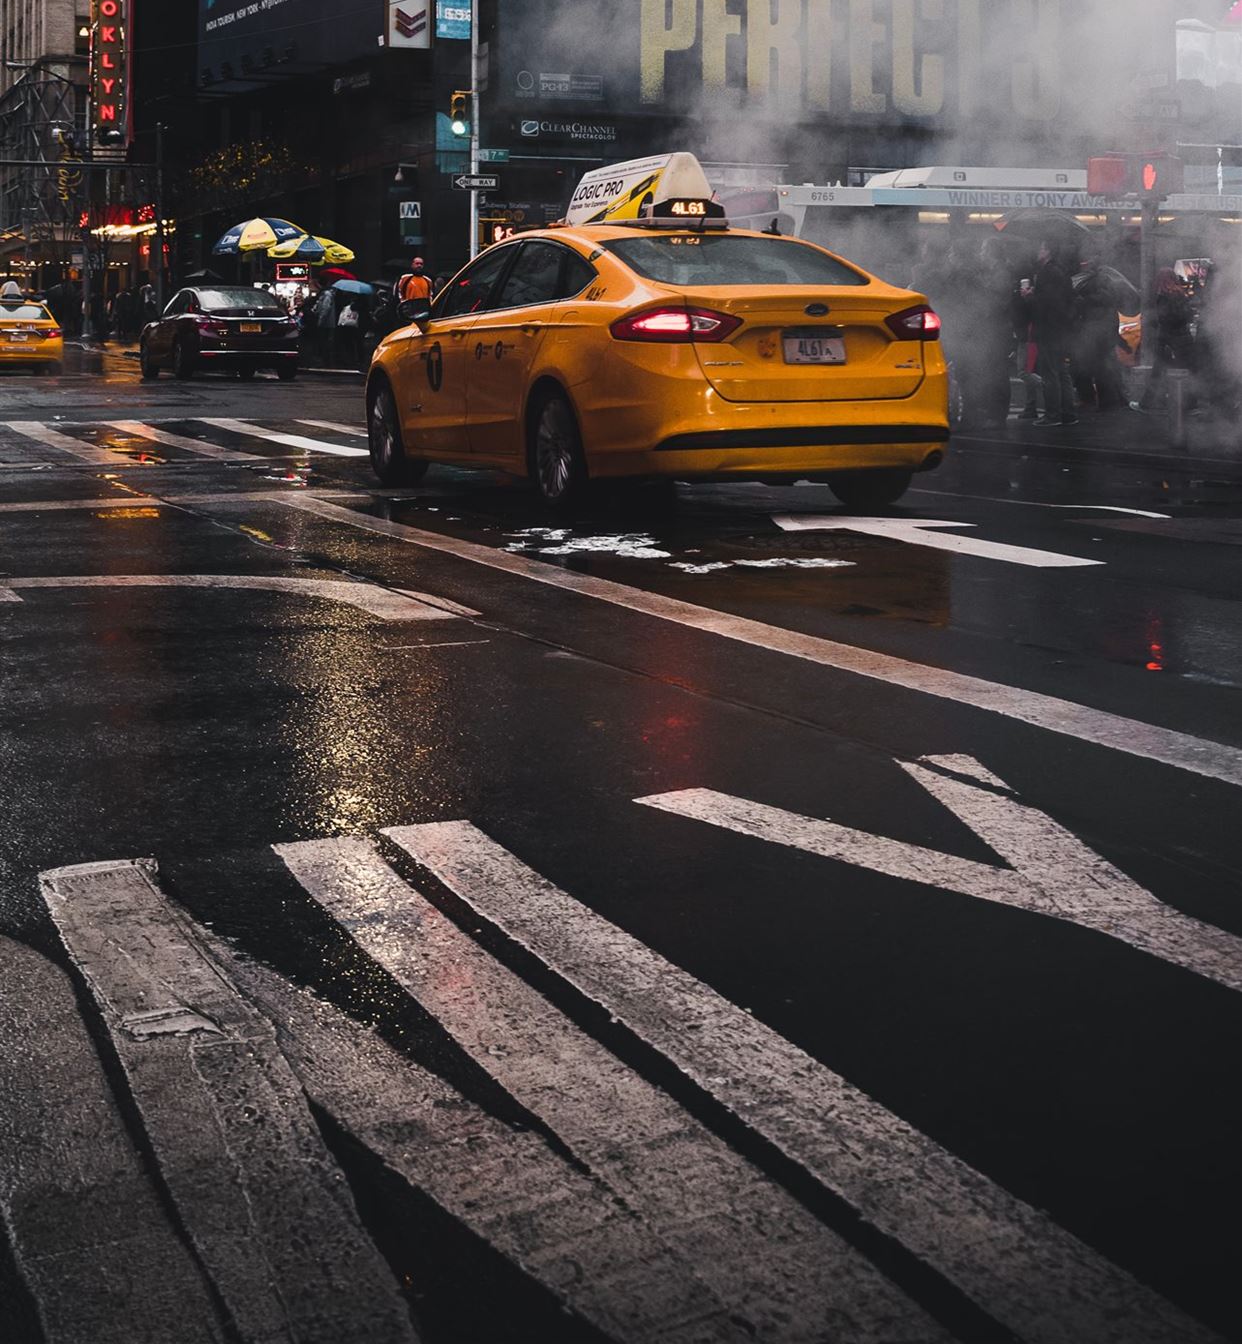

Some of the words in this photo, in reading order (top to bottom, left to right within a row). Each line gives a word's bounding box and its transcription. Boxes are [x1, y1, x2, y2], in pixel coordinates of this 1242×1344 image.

[573, 182, 603, 201] LOGIC
[603, 180, 624, 197] PRO
[811, 191, 834, 202] 6765
[948, 191, 1010, 206] WINNER
[1015, 192, 1022, 206] 6
[1026, 192, 1066, 207] TONY
[671, 201, 706, 216] 4L61
